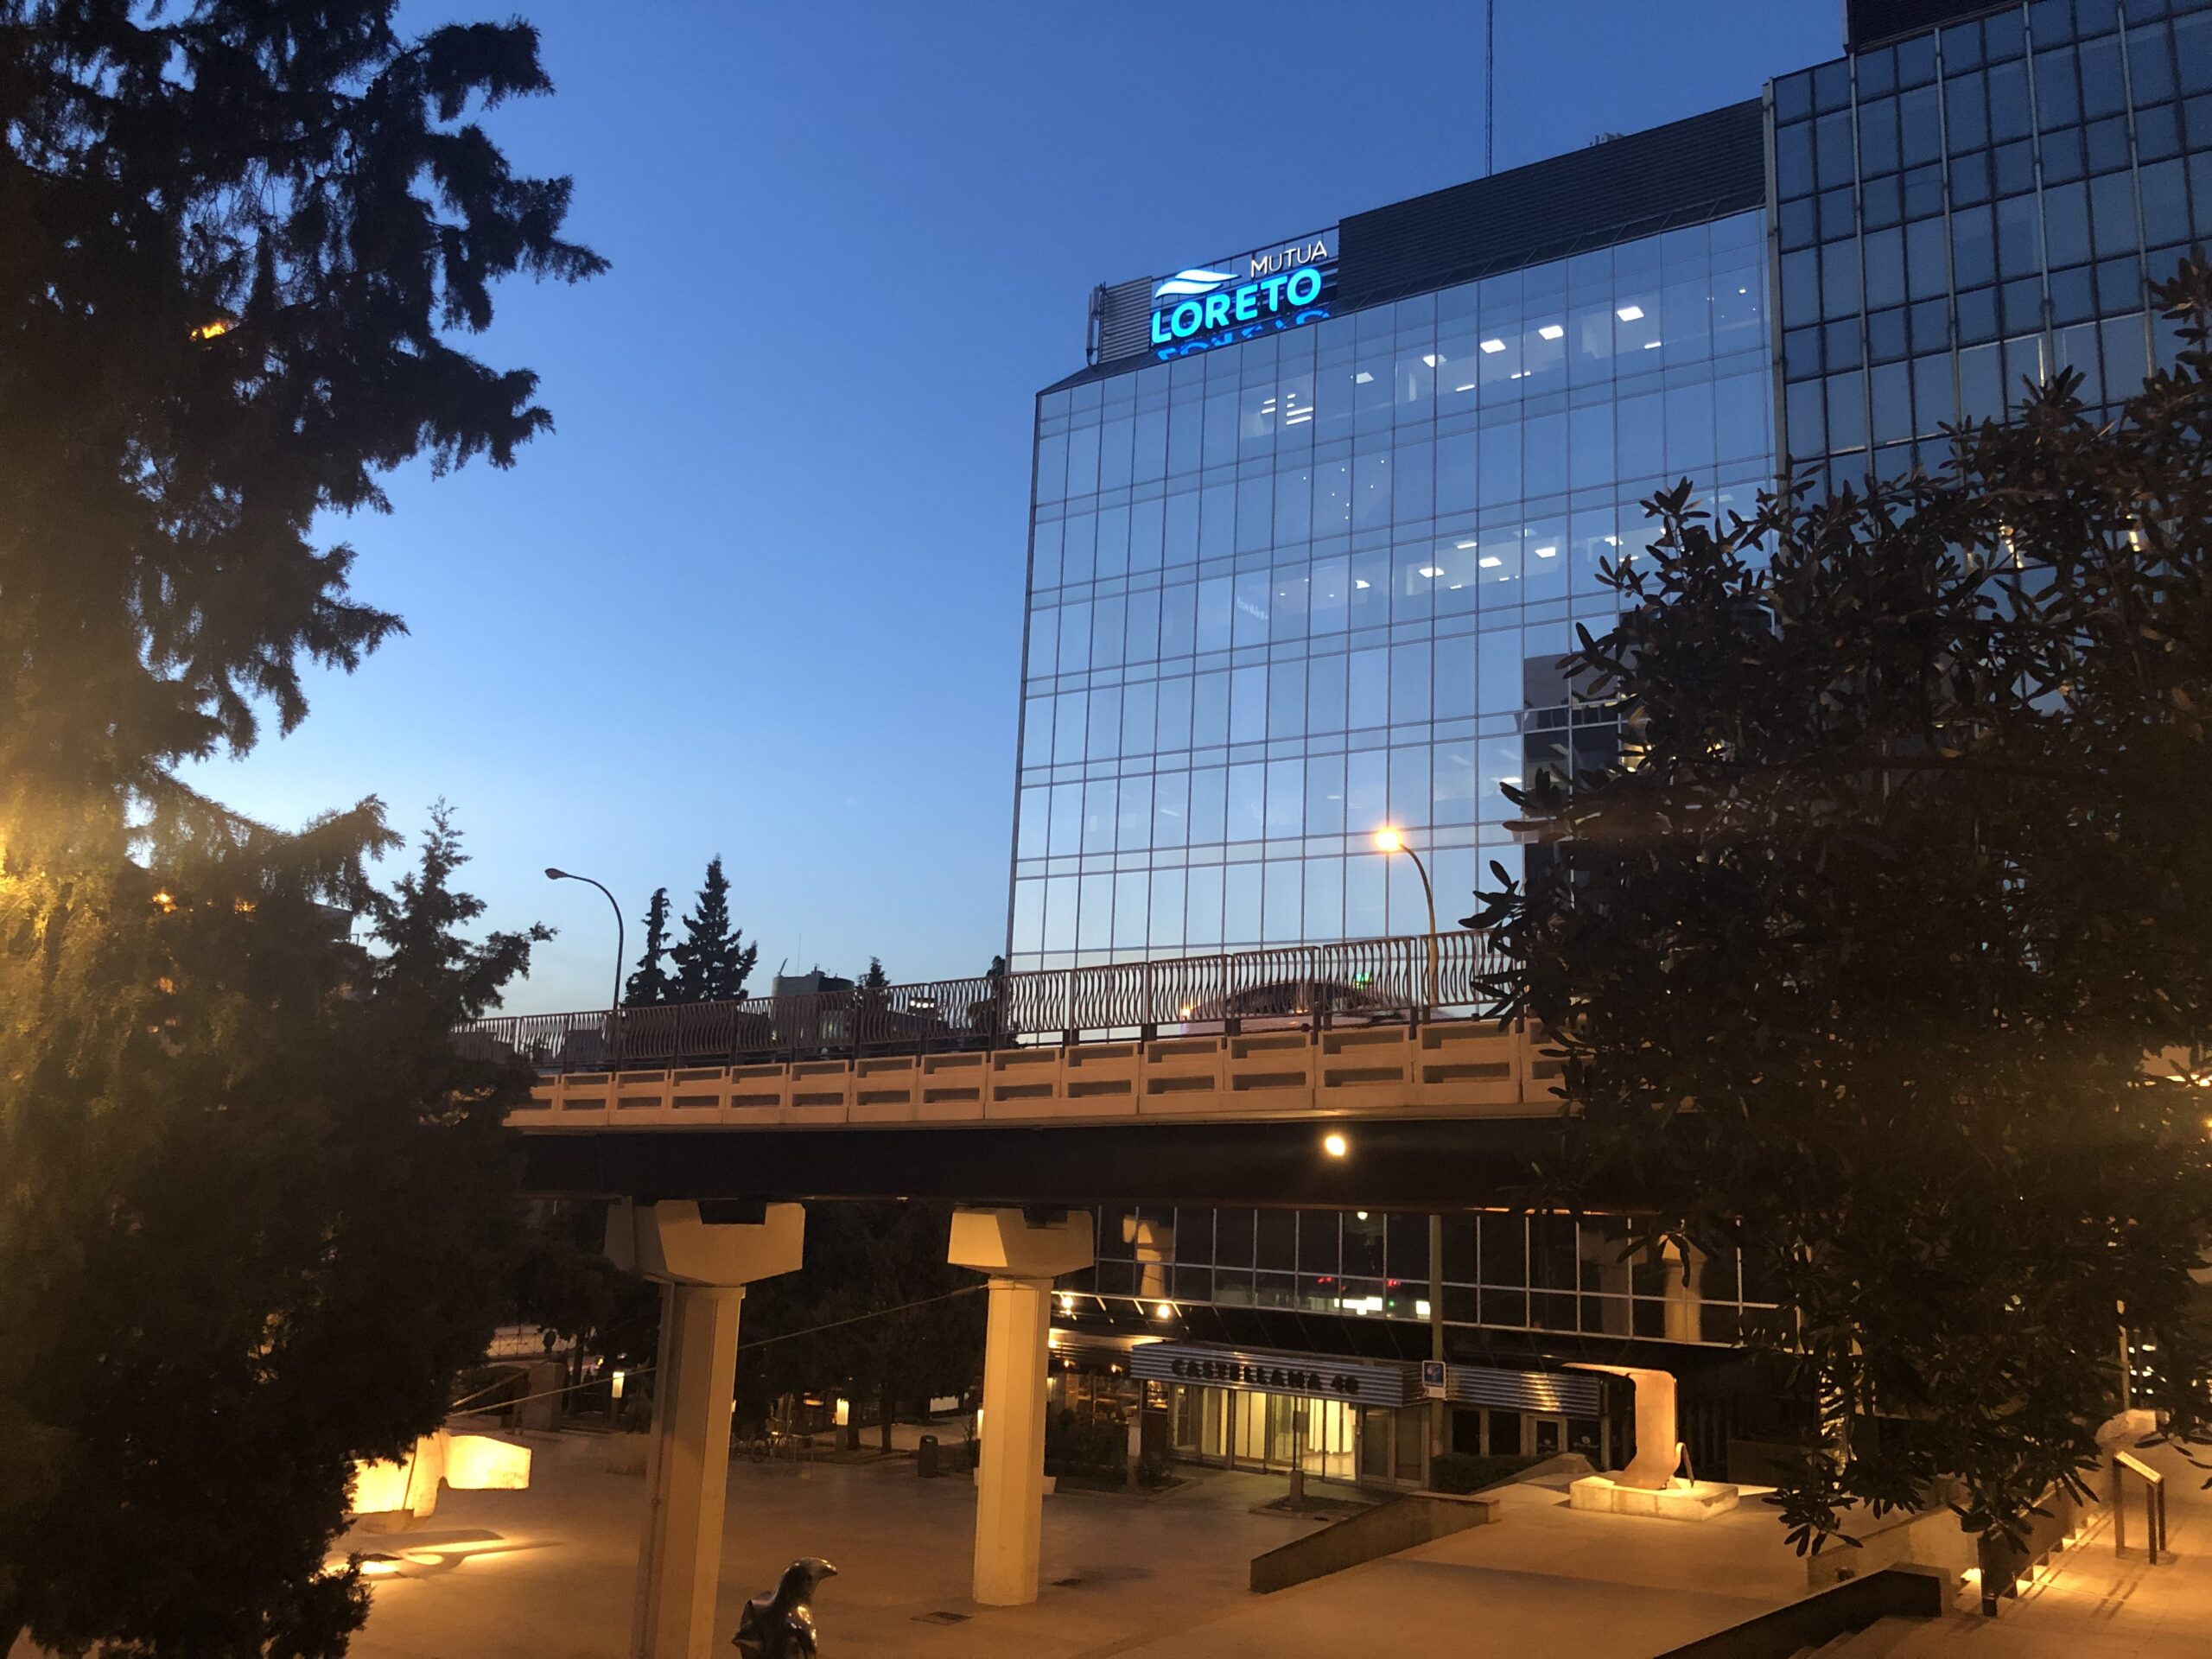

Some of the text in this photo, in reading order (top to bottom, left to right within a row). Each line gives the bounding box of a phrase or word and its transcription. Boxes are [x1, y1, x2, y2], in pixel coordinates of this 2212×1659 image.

[1250, 240, 1328, 278] MUTUA
[1151, 267, 1322, 344] LORETO
[1171, 1358, 1322, 1391] CASTELLANA
